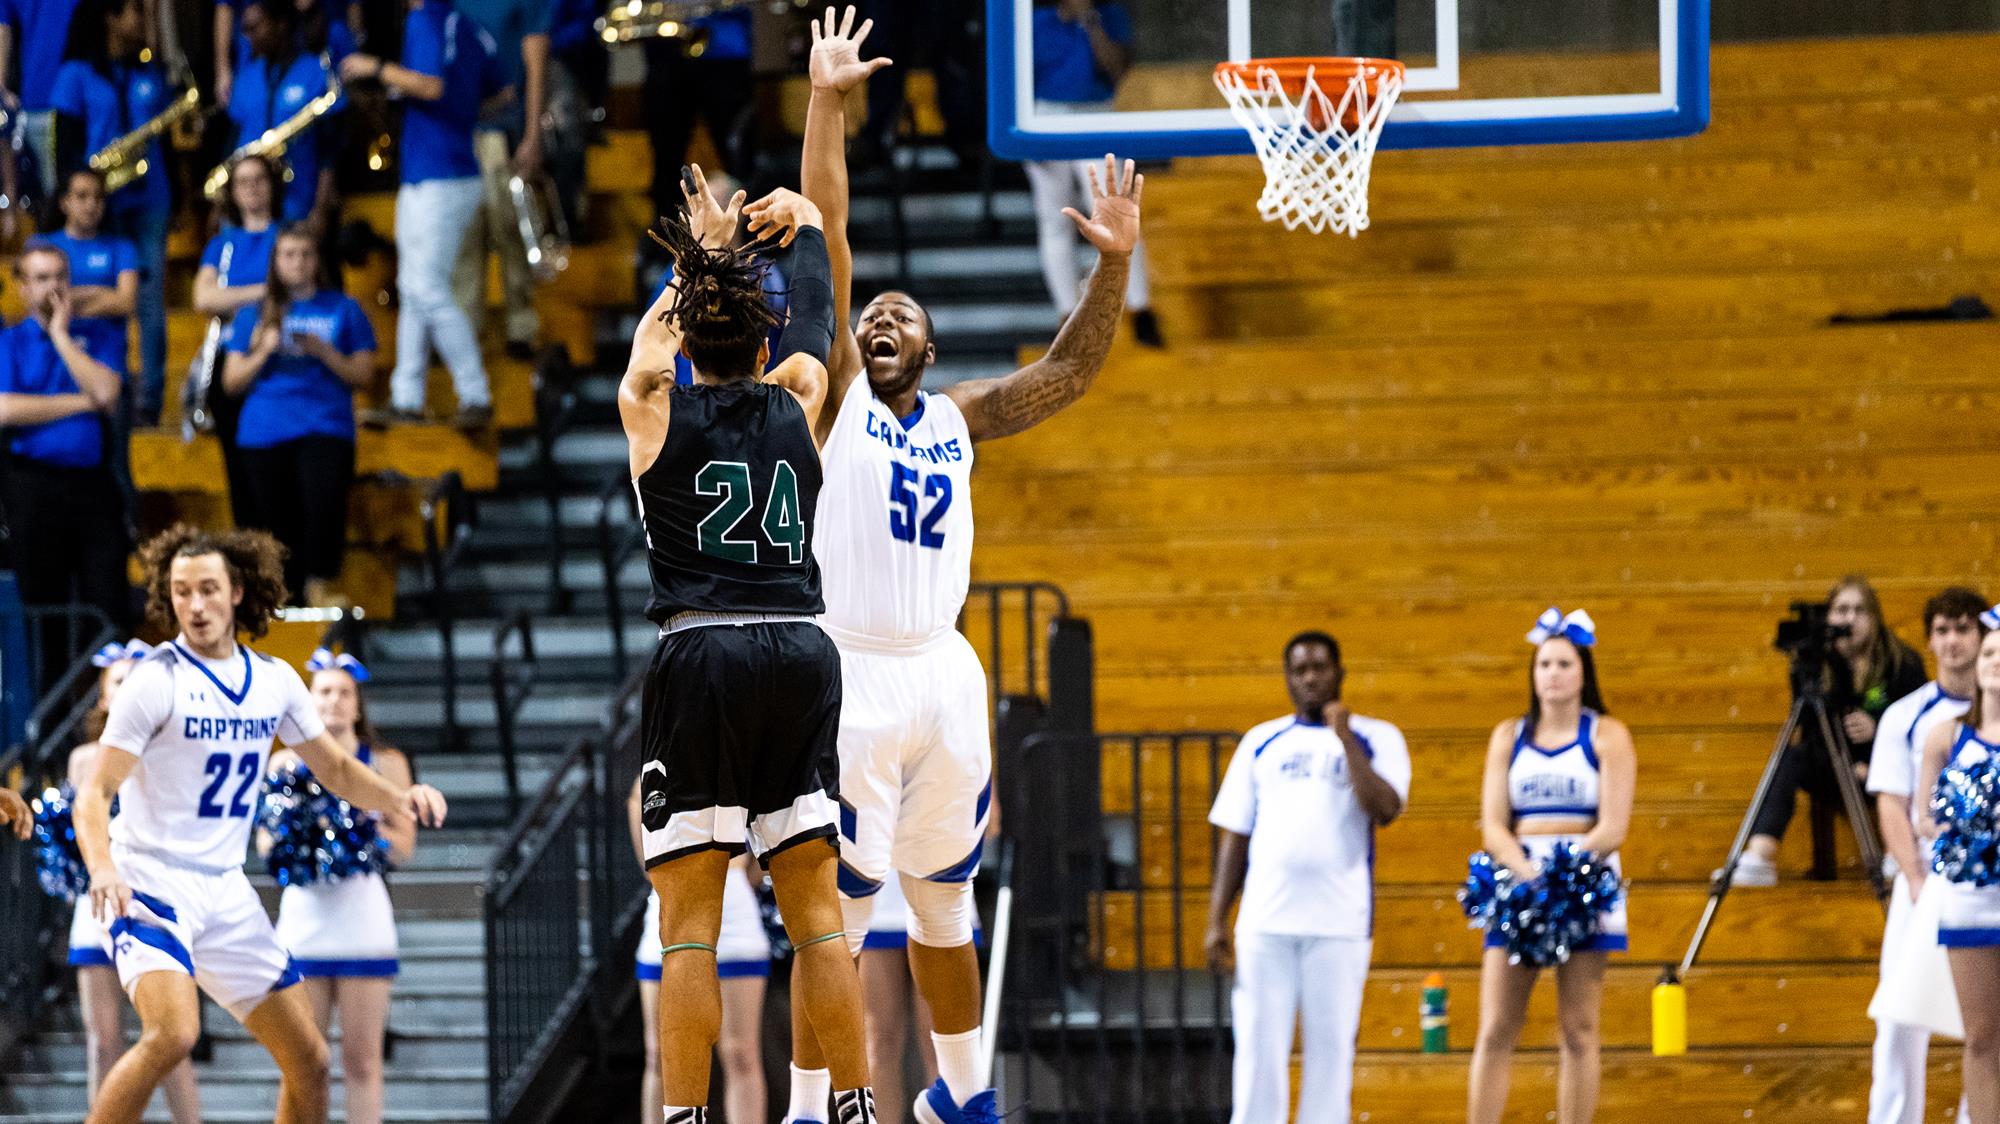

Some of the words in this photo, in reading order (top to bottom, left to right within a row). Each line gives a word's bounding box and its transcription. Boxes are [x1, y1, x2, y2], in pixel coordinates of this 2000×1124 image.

[866, 410, 962, 464] CAPAINS
[695, 460, 805, 564] 24
[889, 461, 953, 549] 52
[198, 752, 259, 818] 22
